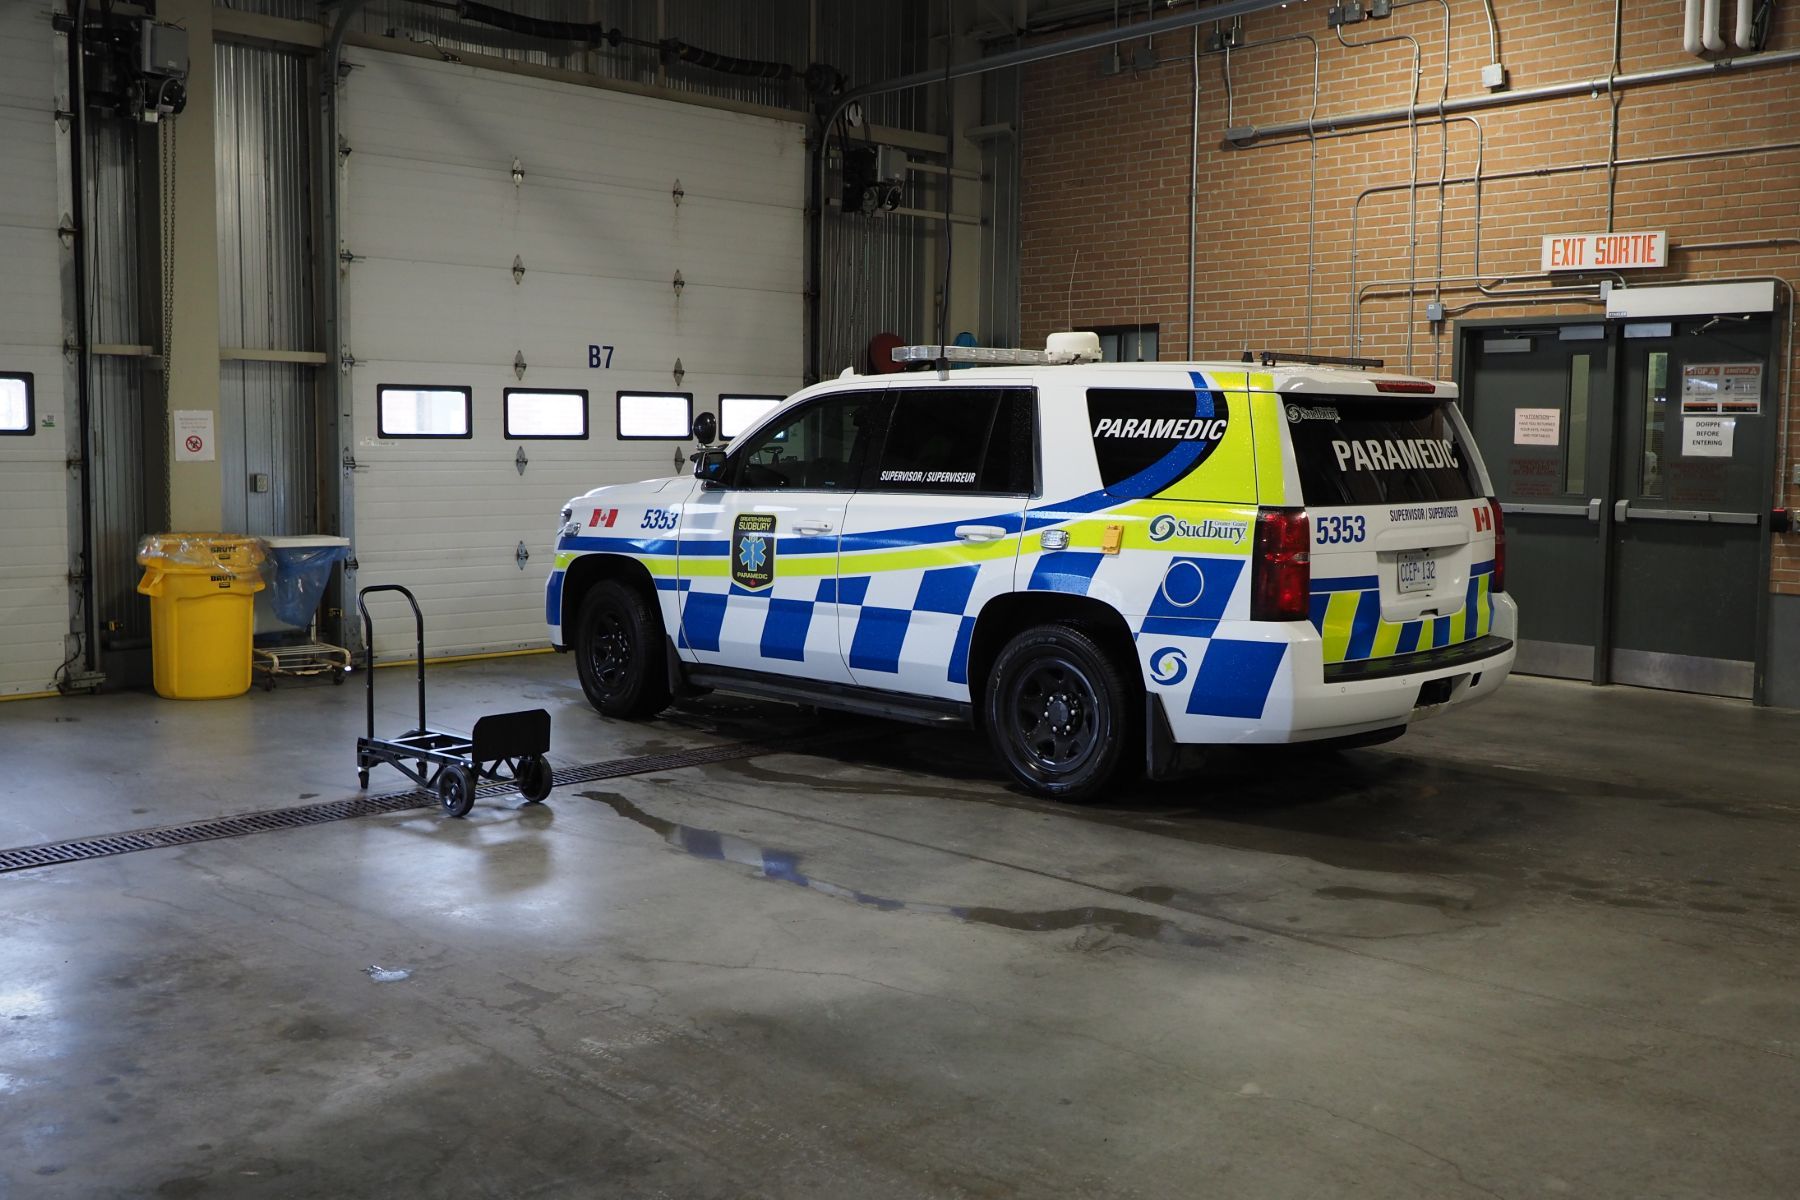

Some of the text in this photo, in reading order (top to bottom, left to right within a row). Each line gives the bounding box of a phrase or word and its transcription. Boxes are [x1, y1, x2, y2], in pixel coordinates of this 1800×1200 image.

[1551, 234, 1658, 266] EXIT SORTIE
[588, 344, 614, 369] B7
[1093, 418, 1227, 440] PARAMEDIC
[1331, 439, 1459, 472] PARAMEDIC
[880, 470, 923, 482] SUPERVISOR
[926, 471, 977, 483] SUPERVISEUR
[640, 509, 679, 530] 5353
[1389, 508, 1425, 522] SUPERVISOR
[1428, 506, 1459, 520] SUPERVISEUR
[738, 521, 772, 531] SUDBURY
[1176, 520, 1246, 545] Sudbury
[1316, 515, 1366, 545] 5353
[737, 571, 768, 580] PARAMEDIC
[1422, 560, 1436, 580] 132
